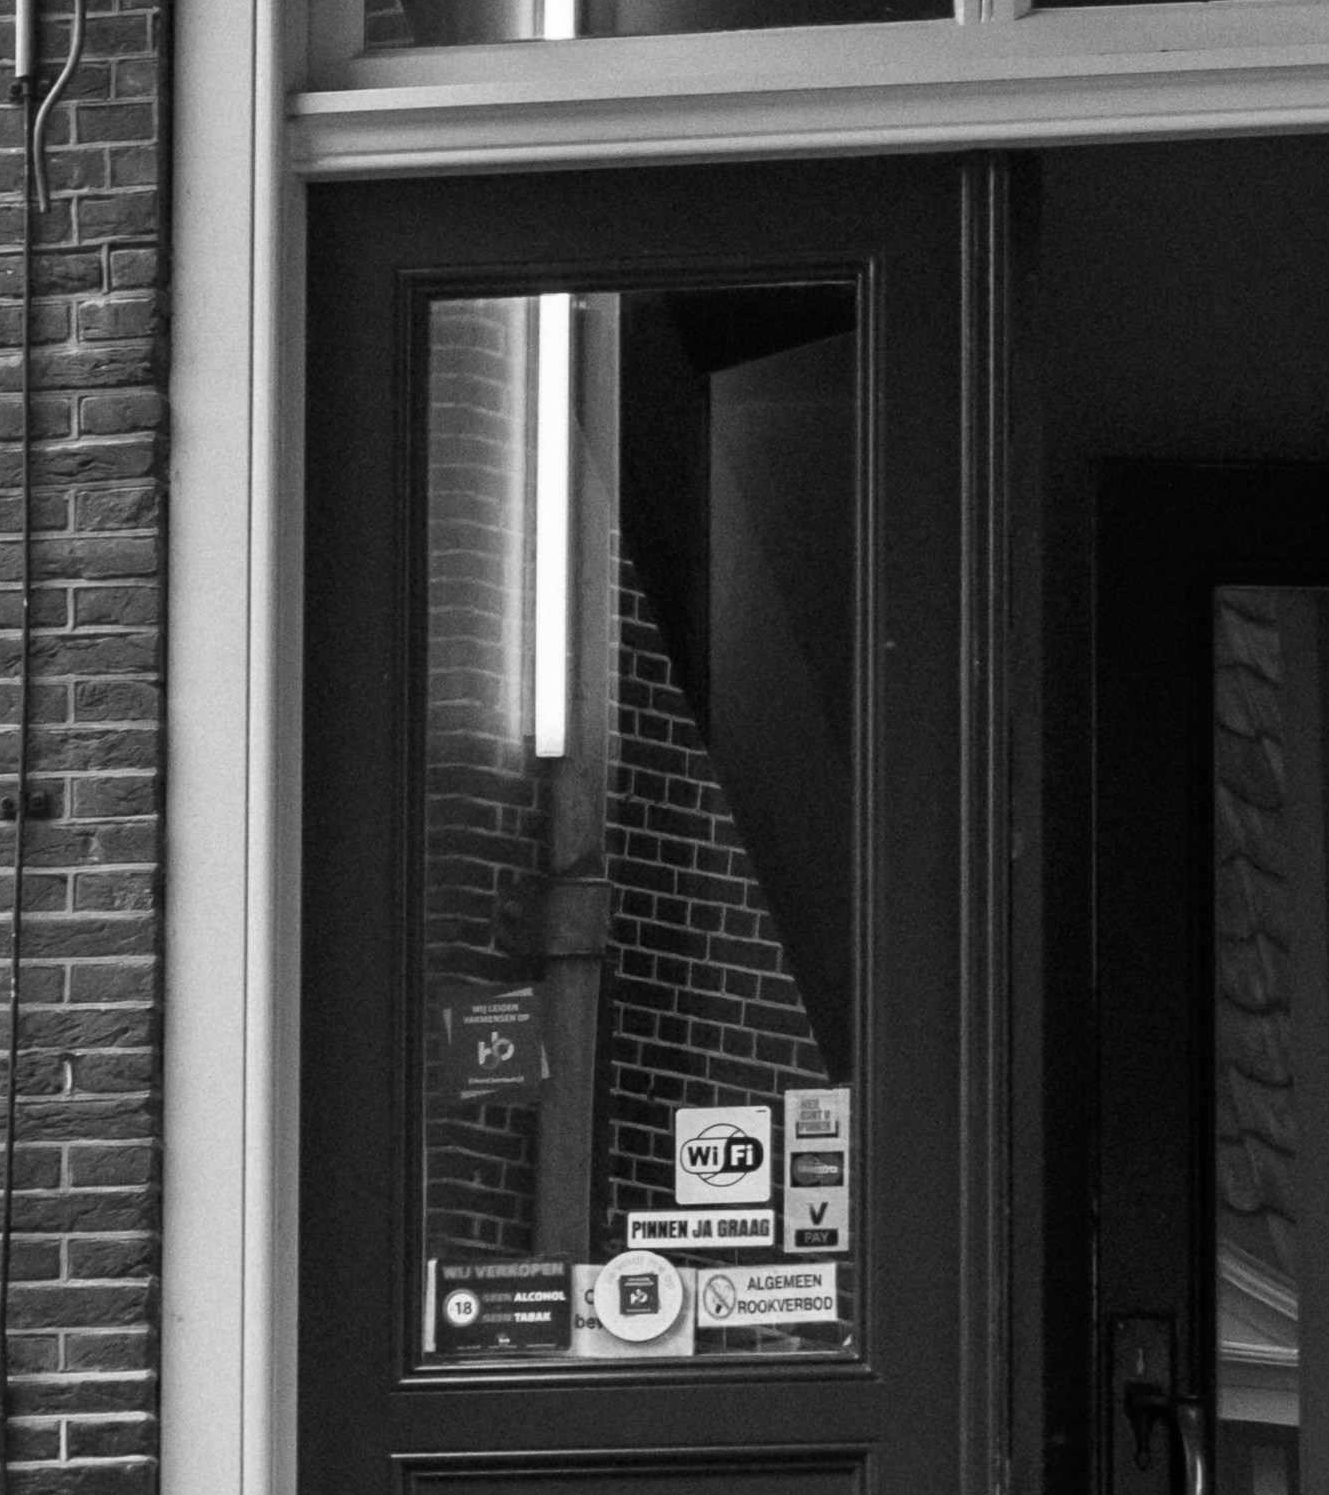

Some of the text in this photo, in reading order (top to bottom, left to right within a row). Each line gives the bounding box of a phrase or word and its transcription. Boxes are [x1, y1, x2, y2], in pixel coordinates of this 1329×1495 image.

[806, 1202, 829, 1226] V
[631, 1218, 770, 1240] PINNEN JA GRAAG
[804, 1232, 830, 1244] PAY
[474, 1263, 565, 1279] VERKOPEN
[748, 1274, 823, 1290] ALGEMEEN
[514, 1291, 566, 1303] ALCOHOL
[737, 1296, 833, 1314] ROOKVERBOD
[455, 1301, 473, 1315] 18
[513, 1312, 552, 1323] TABAK
